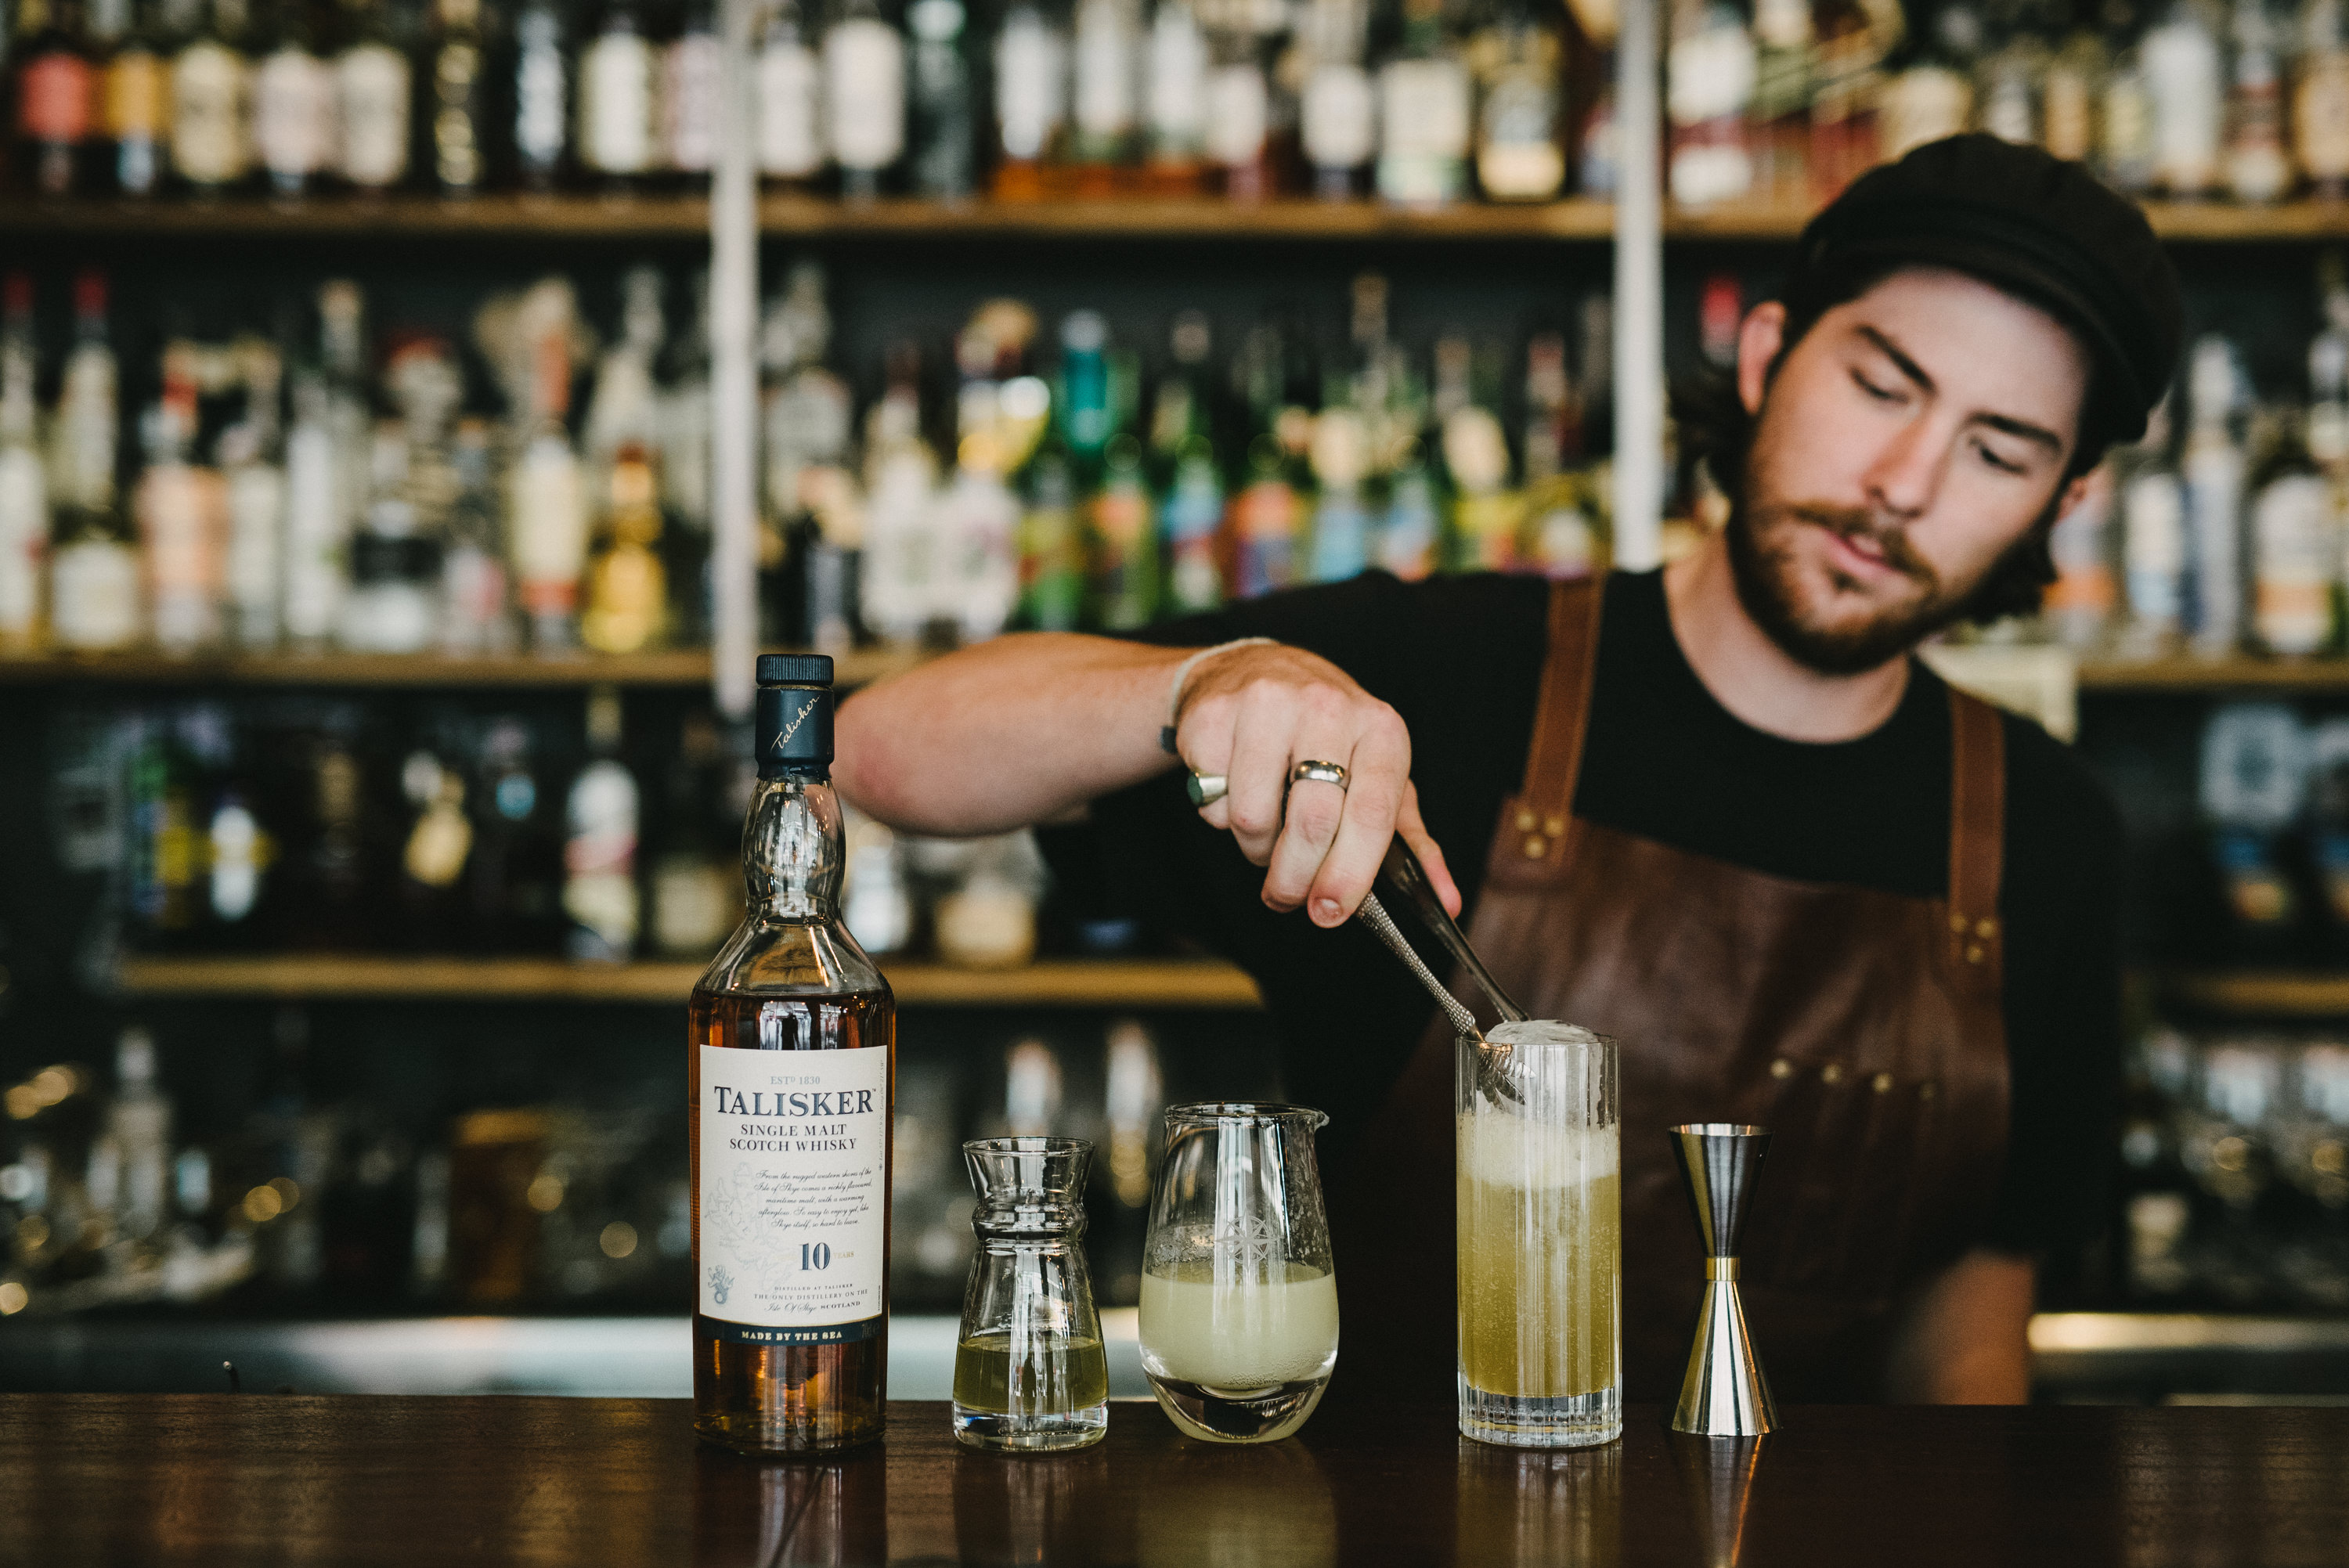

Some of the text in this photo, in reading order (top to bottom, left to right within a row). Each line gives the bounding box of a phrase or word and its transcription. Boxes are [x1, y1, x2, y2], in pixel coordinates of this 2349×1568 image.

[770, 695, 821, 752] Talisker
[799, 1076, 821, 1085] 1830
[714, 1086, 874, 1117] TALISKER
[741, 1123, 847, 1136] SINGLE MALT
[730, 1137, 857, 1152] SCOTCH WHISKY
[755, 1170, 779, 1180] From
[792, 1172, 815, 1183] rugged
[754, 1182, 770, 1191] Isle
[771, 1184, 779, 1195] of
[779, 1183, 800, 1195] Skye
[771, 1220, 792, 1231] Skye
[799, 1242, 831, 1271] 10
[821, 1300, 861, 1310] SCOTLAND
[742, 1331, 772, 1340] MADE
[795, 1332, 818, 1341] THE
[821, 1331, 843, 1339] SEA
